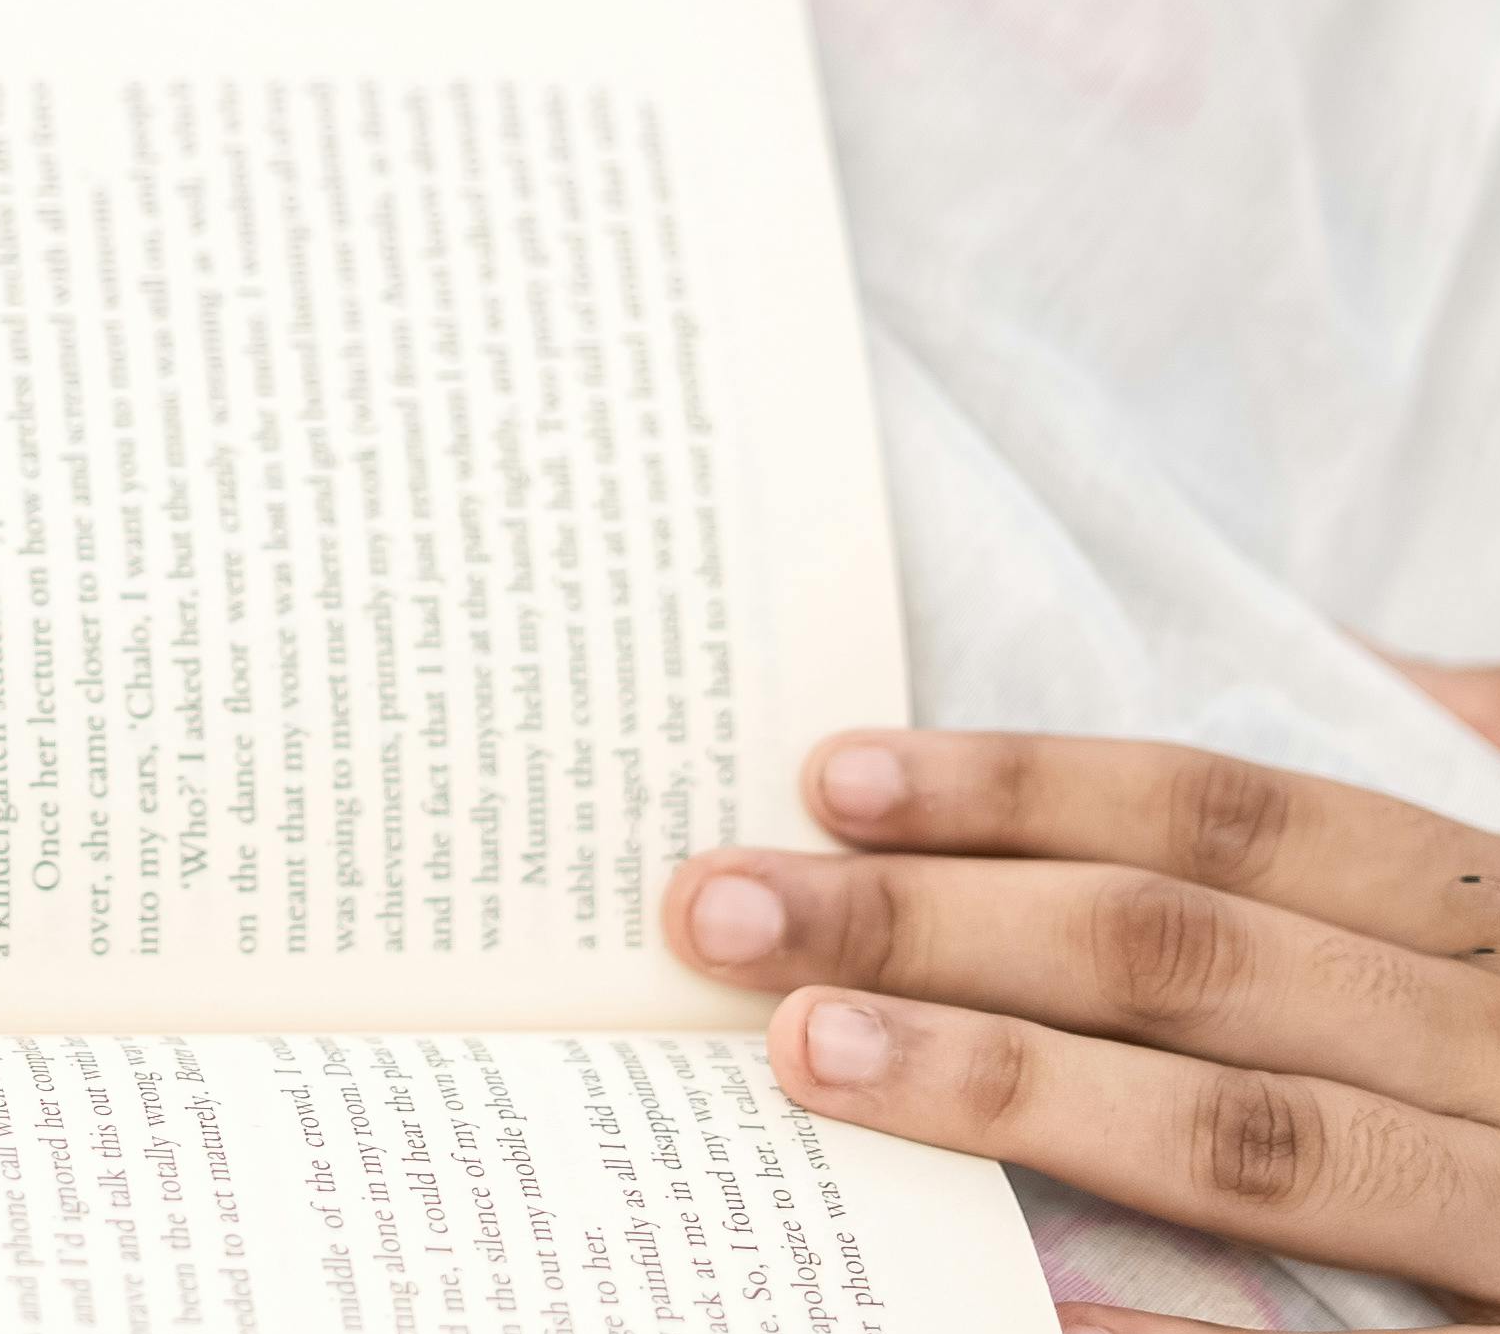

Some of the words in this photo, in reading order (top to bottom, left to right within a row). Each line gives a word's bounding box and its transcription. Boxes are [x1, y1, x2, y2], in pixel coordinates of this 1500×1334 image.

[26, 617, 56, 725] lecture
[28, 736, 58, 789] her
[32, 802, 60, 892] Once
[65, 1052, 102, 1080] with
[579, 1069, 606, 1098] was
[85, 1087, 112, 1115] out
[134, 1072, 165, 1127] wrong
[341, 1083, 372, 1136] room.
[384, 1086, 415, 1112] the
[435, 1075, 464, 1110] own
[481, 1067, 527, 1122] phone
[34, 1099, 64, 1129] her
[280, 1085, 324, 1147] crowd,
[584, 1106, 621, 1134] did
[89, 1125, 122, 1157] this
[184, 1092, 231, 1181] maturely.
[401, 1120, 431, 1163] hear
[451, 1118, 480, 1149] my
[701, 1131, 730, 1162] my
[143, 1136, 183, 1201] totally
[305, 1160, 336, 1192] the
[358, 1142, 387, 1174] my
[451, 1153, 484, 1177] of
[496, 1127, 542, 1198] mobile
[602, 1159, 637, 1181] all
[755, 1142, 784, 1178] her.
[37, 1138, 90, 1221] ignored
[362, 1182, 390, 1203] in
[665, 1182, 693, 1201] in
[213, 1190, 239, 1223] act
[310, 1201, 343, 1229] of
[405, 1173, 448, 1233] could
[623, 1190, 645, 1208] as
[705, 1171, 753, 1234] found
[773, 1190, 794, 1209] to
[818, 1182, 846, 1219] was
[373, 1210, 405, 1273] alone
[472, 1187, 507, 1263] silence
[527, 1205, 557, 1242] my
[681, 1213, 707, 1246] me
[582, 1227, 611, 1270] her.
[536, 1250, 564, 1290] out
[624, 1215, 689, 1321] painfully
[691, 1258, 715, 1278] at
[743, 1265, 772, 1301] So,
[780, 1221, 838, 1334] apologize
[837, 1233, 884, 1307] phone
